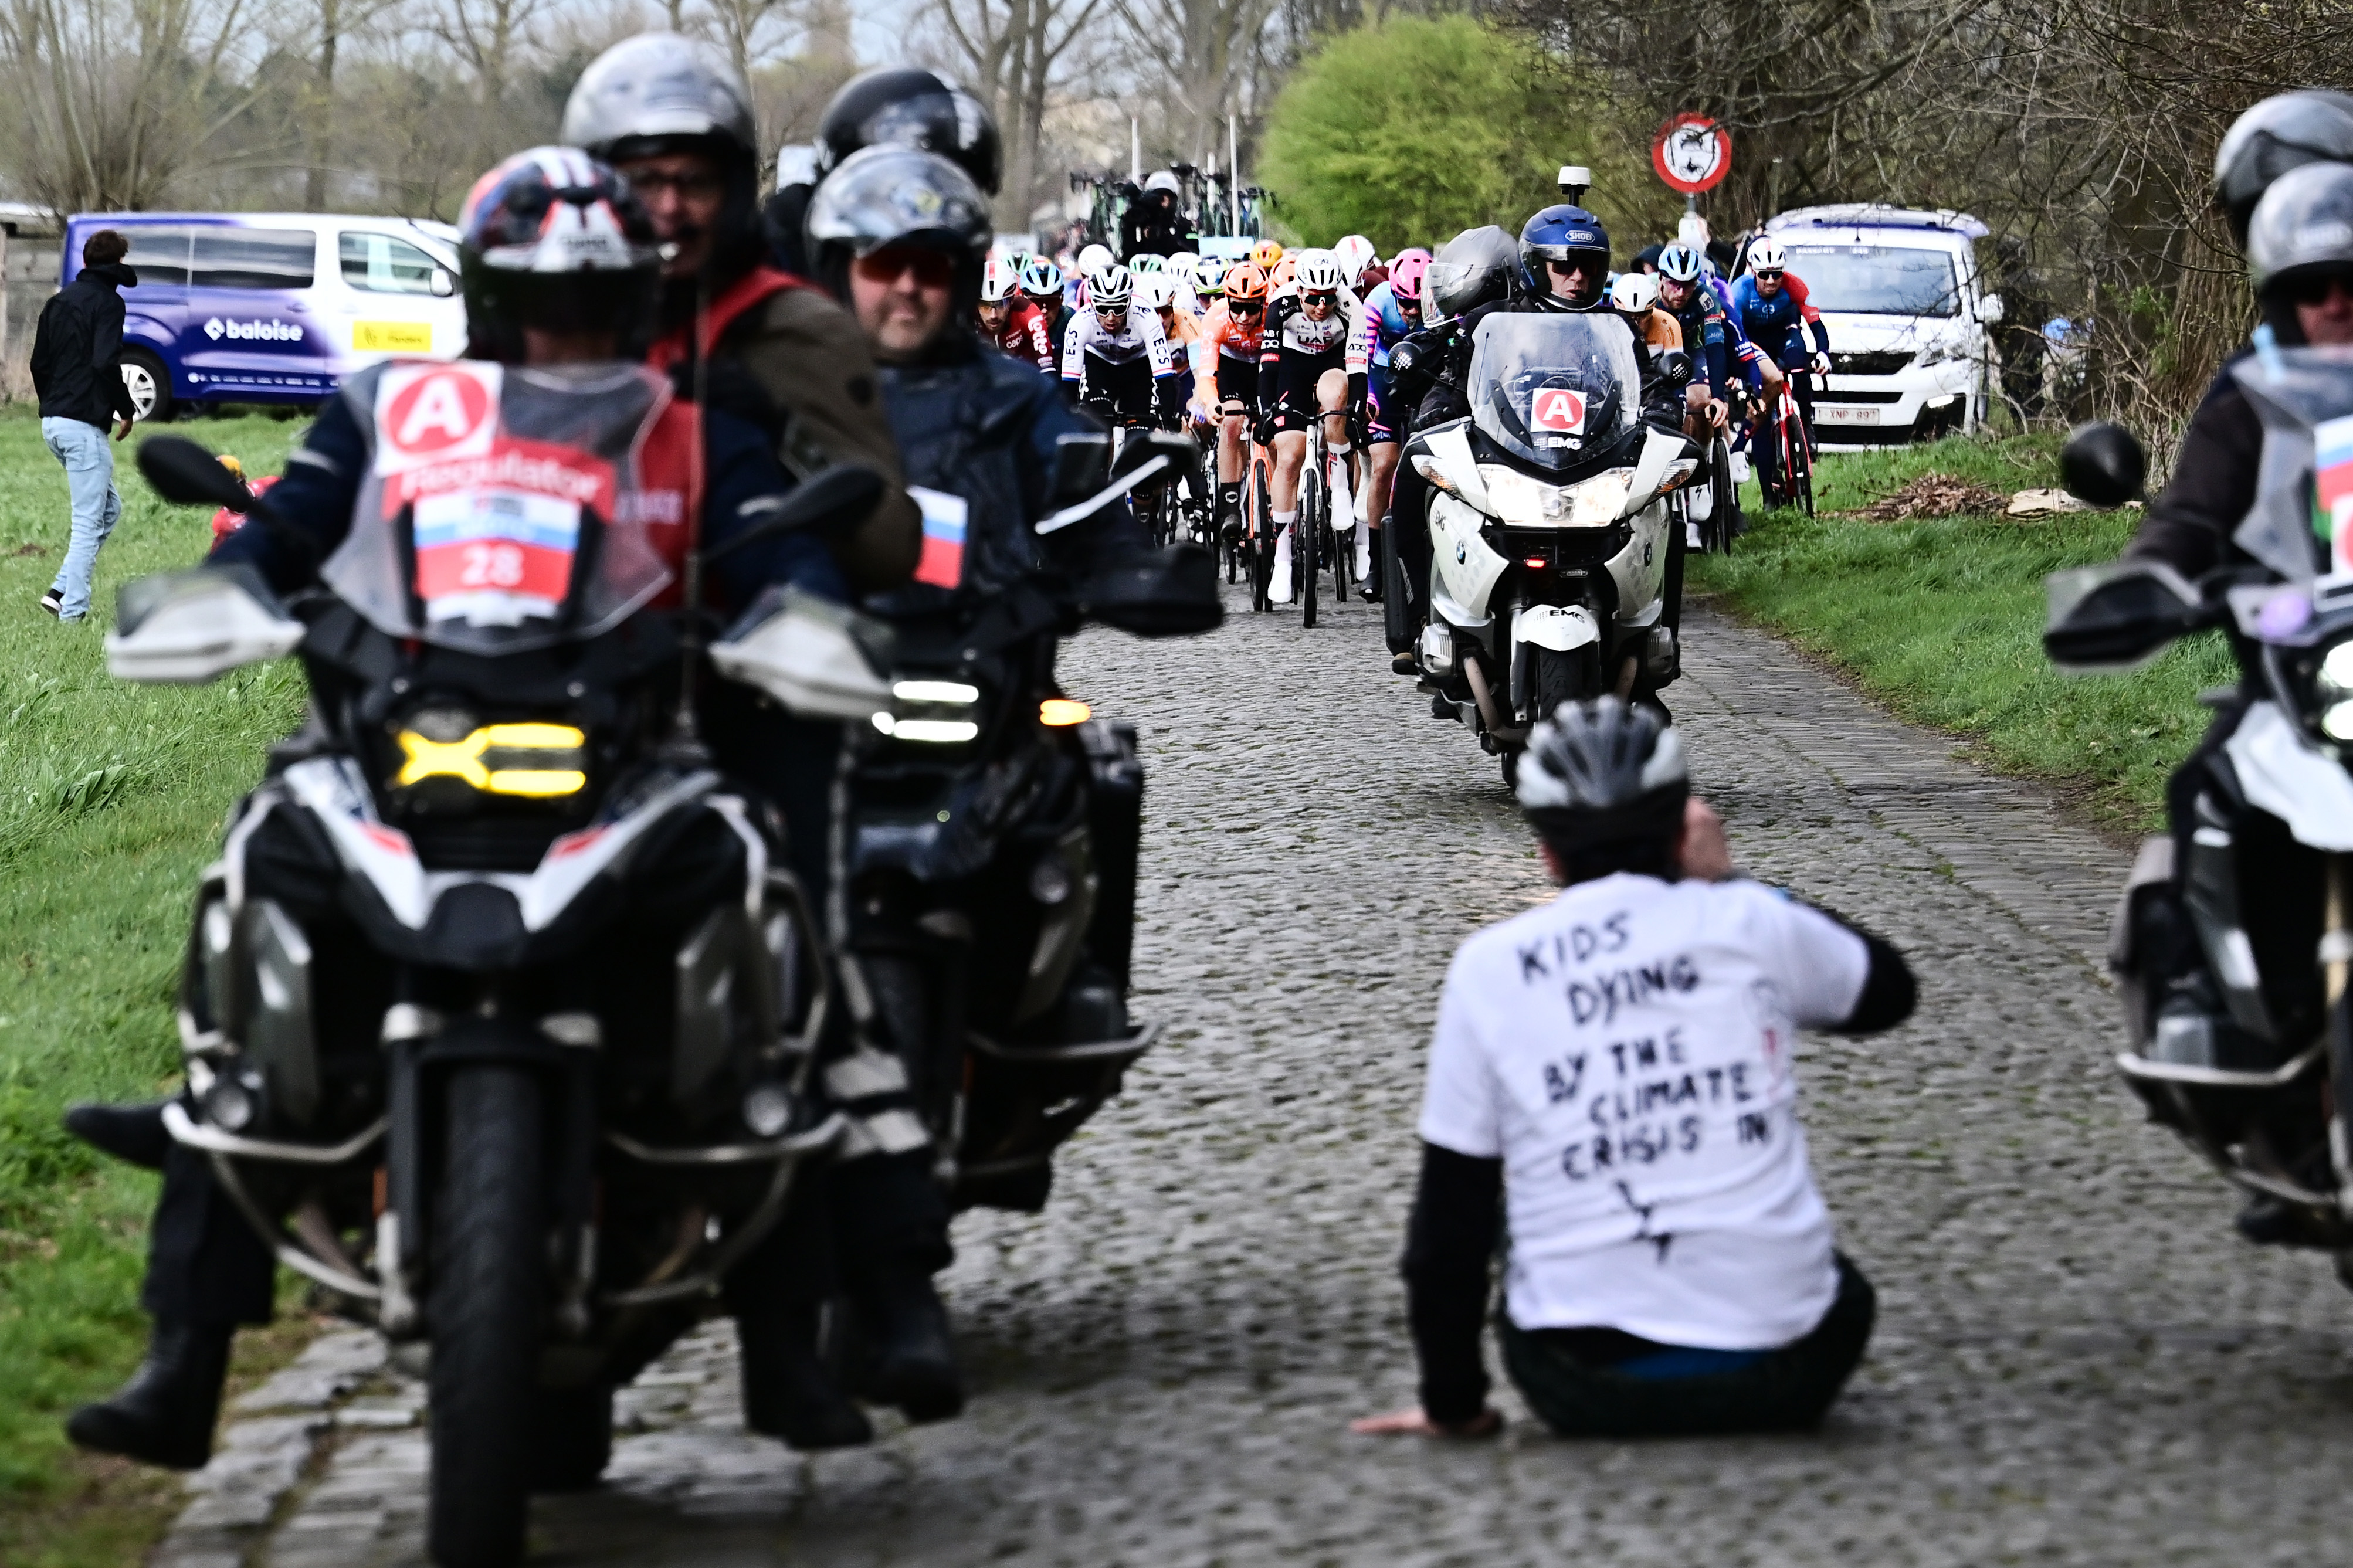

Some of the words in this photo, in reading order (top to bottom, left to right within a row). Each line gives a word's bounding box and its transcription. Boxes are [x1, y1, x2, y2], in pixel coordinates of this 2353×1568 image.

[1569, 232, 1592, 241] SHOEI
[226, 318, 304, 341] baloise
[1028, 314, 1048, 355] lotto
[1063, 327, 1078, 369] INEOS
[1149, 324, 1170, 365] INEOS
[1200, 329, 1215, 369] INEOS
[398, 379, 468, 446] A
[1542, 394, 1574, 423] A
[1548, 437, 1582, 450] EMG
[400, 449, 601, 503] Regulator
[460, 543, 525, 587] 28
[1549, 609, 1585, 624] EMG
[1517, 909, 1630, 984] KIDS
[1567, 953, 1701, 1030] DYING
[1542, 1053, 1586, 1104] BY
[1608, 1026, 1687, 1075] THE
[1588, 1061, 1752, 1129] CLIMATE
[1561, 1115, 1702, 1181] CRISIS
